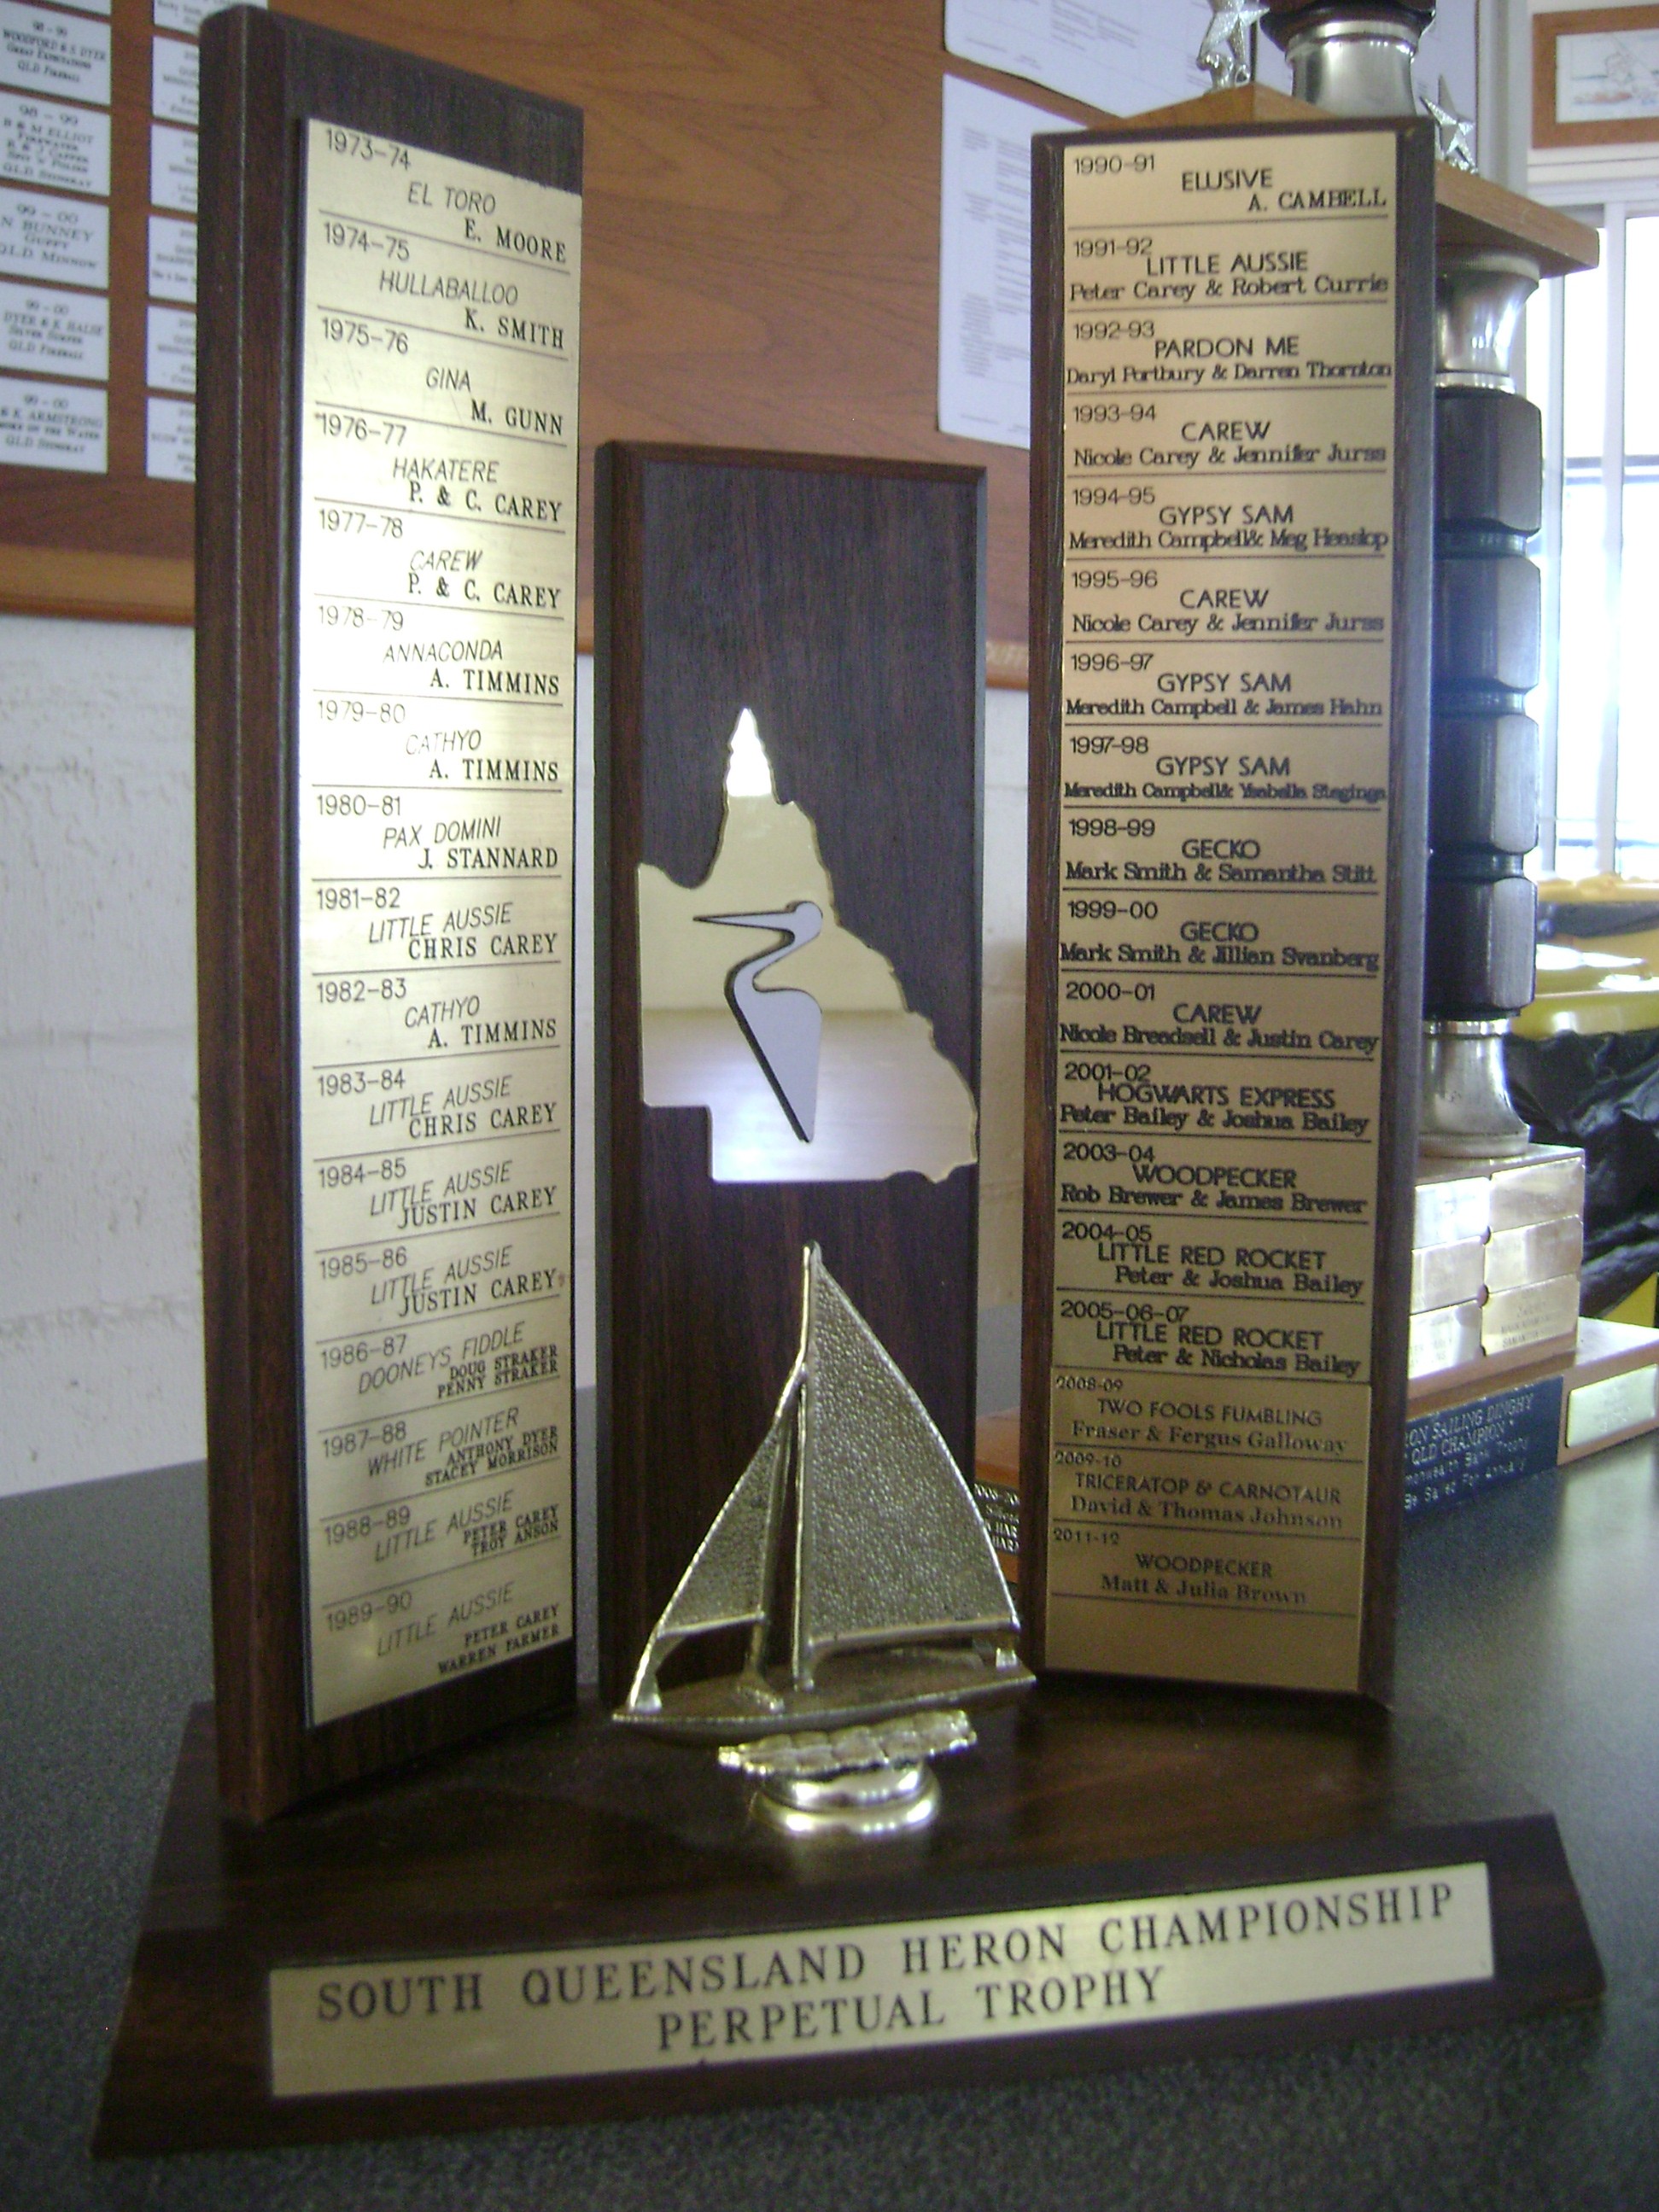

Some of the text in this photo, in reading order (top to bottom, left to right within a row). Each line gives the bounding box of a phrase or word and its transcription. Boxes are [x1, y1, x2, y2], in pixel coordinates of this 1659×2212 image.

[326, 129, 411, 169] 1973-74
[1075, 155, 1154, 174] 1990-91
[1183, 168, 1273, 192] ELUSIVE
[409, 183, 495, 215] EL TORO
[1249, 195, 1267, 211] A.
[324, 223, 409, 261] 1974-75
[464, 218, 566, 263] E. MOORE
[1074, 238, 1153, 258] 1991-92
[1147, 252, 1307, 277] LITTLE AUSSIE
[380, 271, 518, 306] HULLABALLOO
[1070, 274, 1388, 301] Peter Carey Robert Currie
[322, 318, 408, 354] 1975-76
[464, 307, 564, 350] K. SMITH
[1074, 322, 1154, 340] 1992-93
[1154, 336, 1299, 359] PARDON ME
[426, 367, 471, 392] GINA
[1067, 368, 1114, 387] Daryl
[471, 400, 564, 435] M. GUNN
[1073, 405, 1155, 423] 1993-94
[321, 414, 406, 446] 1976-77
[1182, 422, 1270, 441] CAREW
[394, 457, 499, 483] HAKATERE
[1074, 447, 1200, 468] Nicole Carey
[409, 480, 562, 522] P. C. CAREY
[1072, 487, 1154, 505] 1994-95
[319, 510, 403, 538] 1977-78
[1160, 505, 1294, 526] GYPSY SAM
[410, 550, 482, 572] CAREW
[409, 572, 561, 609] P. C. CAREY
[1072, 571, 1157, 588] 1995-96
[1180, 590, 1269, 609] CAREW
[318, 606, 404, 630] 1978-79
[1072, 616, 1198, 635] Nicole Carey
[383, 640, 503, 662] ANNACONDA
[1071, 654, 1154, 671] 1996-97
[430, 668, 559, 695] A. TIMMINS
[1158, 674, 1291, 692] GYPSY SAM
[318, 700, 405, 723] 1979-80
[406, 730, 481, 755] CATHYO
[1070, 737, 1148, 754] 1997-98
[429, 758, 558, 781] A. TIMMINS
[1156, 757, 1290, 776] GYPSY SAM
[317, 794, 401, 815] 1980-81
[383, 816, 501, 849] PAX DOMINI
[1069, 820, 1155, 837] 1998-99
[418, 847, 558, 869] J. STANNARD
[1182, 839, 1260, 859] GECKO
[1066, 862, 1117, 880] Mark
[317, 888, 400, 909] 1981-82
[1068, 902, 1158, 919] 1999-00
[369, 902, 512, 943] LITTLE AUSSIE
[1180, 922, 1259, 942] GECKO
[409, 933, 557, 960] CHRIS CAREY
[317, 978, 406, 1002] 1982-83
[1066, 983, 1154, 1001] 2000-01
[406, 995, 480, 1028] CATHYO
[1173, 1004, 1261, 1024] CAREW
[428, 1019, 557, 1048] A. TIMMINS
[318, 1068, 406, 1096] 1983-84
[1065, 1064, 1151, 1082] 2001-02
[370, 1076, 512, 1126] LITTLE AUSSIE
[1098, 1083, 1335, 1108] HOGWARTS EXPRESS
[410, 1102, 557, 1139] CHRIS CAREY
[1064, 1143, 1154, 1163] 2003-04
[318, 1159, 406, 1188] 1984-85
[1133, 1164, 1296, 1188] WOODPECKER
[370, 1161, 512, 1216] LITTLE AUSSIE
[398, 1187, 557, 1229] JUSTIN CAREY
[1062, 1223, 1152, 1241] 2004-05
[319, 1247, 406, 1278] 1985-86
[1099, 1242, 1326, 1269] LITTLE RED ROCKET
[371, 1246, 512, 1304] LITTLE AUSSIE
[399, 1269, 558, 1317] JUSTIN CAREY
[1060, 1301, 1189, 1322] 2005-06-07
[1097, 1322, 1323, 1349] LITTLE RED ROCKET
[321, 1334, 406, 1368] 1986-87
[359, 1322, 525, 1394] DOONEYS FIDDLE
[495, 1345, 558, 1369] STRAKER
[495, 1361, 558, 1384] STRAKER
[1097, 1399, 1323, 1427] TWO FOOLS FUMBLING
[323, 1421, 406, 1457] 1987-88
[368, 1407, 518, 1476] WHITE POINTER
[425, 1464, 476, 1486] STACEY
[324, 1507, 411, 1545] 1988-89
[375, 1491, 514, 1561] LITTLE AUSSIE
[377, 1582, 514, 1657] LITTLE AUSSIE
[317, 1882, 1454, 2022] SOUTH QUEENSLAND HERON CHAMPIONSHIP
[659, 1965, 1164, 2051] PERPETUAL TROPHY
